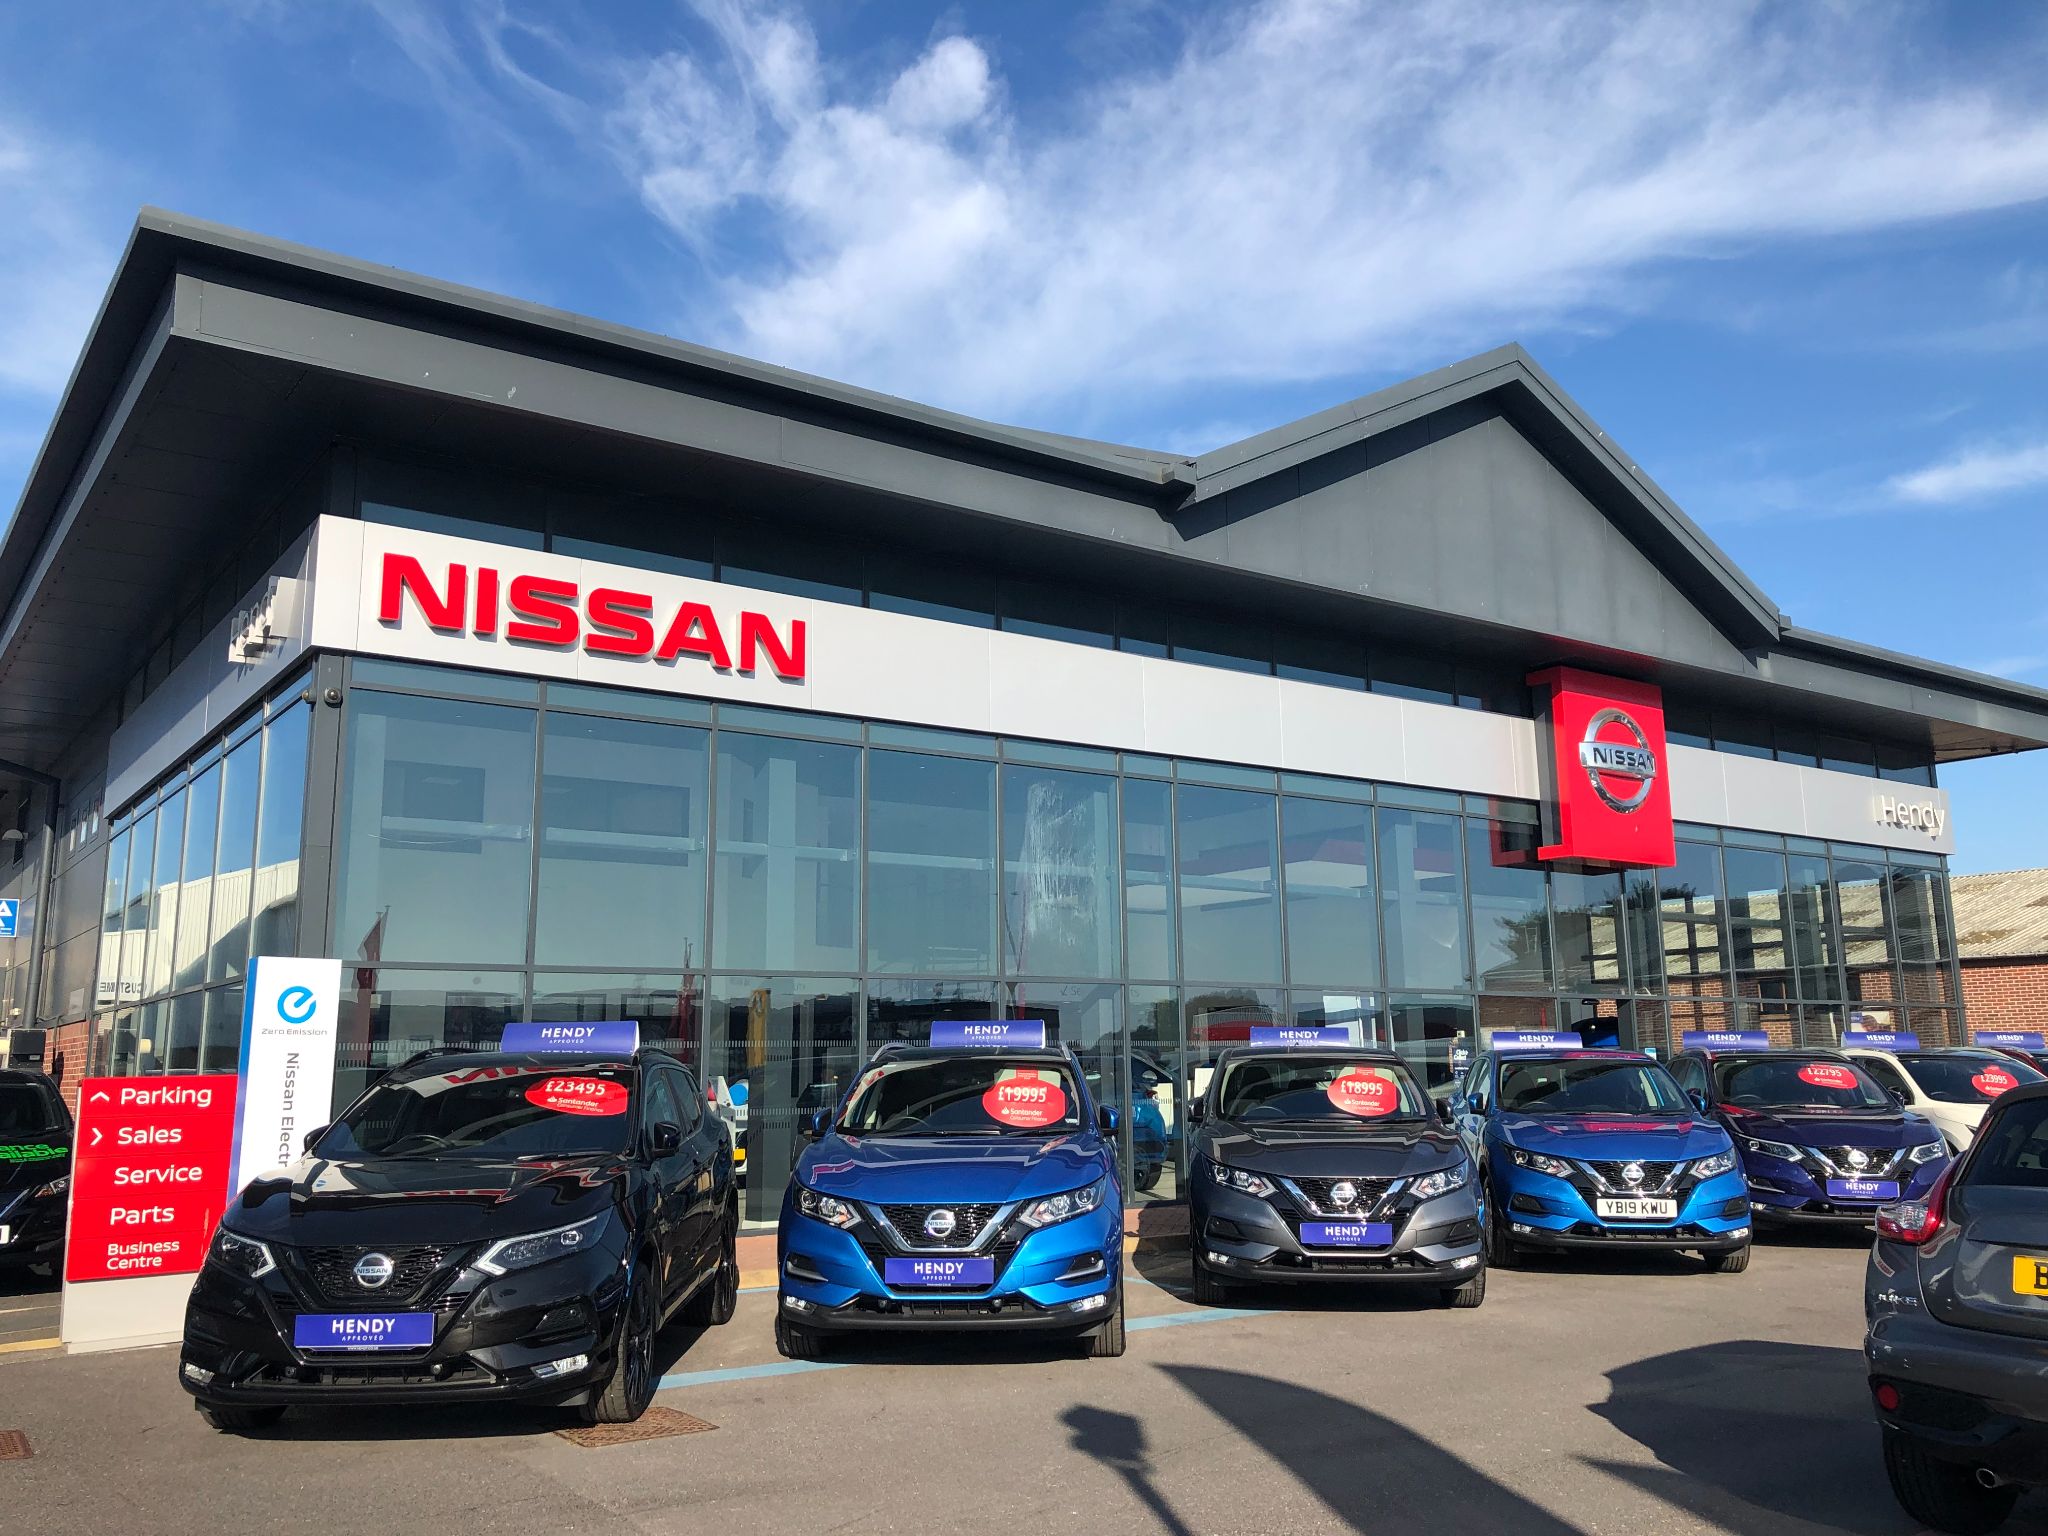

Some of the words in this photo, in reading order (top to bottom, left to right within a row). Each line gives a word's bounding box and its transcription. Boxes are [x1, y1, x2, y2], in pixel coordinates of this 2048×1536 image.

[377, 552, 806, 682] NISSAN
[1592, 747, 1655, 771] NISSAN
[1879, 794, 1945, 837] Hendy
[261, 1027, 285, 1036] Zero
[286, 1028, 328, 1036] Emission
[541, 1026, 596, 1038] HENDY
[964, 1025, 1009, 1035] HENDY
[1279, 1030, 1319, 1039] HENDY
[282, 1052, 300, 1111] Nissan
[545, 1080, 606, 1096] £23495
[1340, 1080, 1384, 1096] £18995
[120, 1087, 212, 1108] Parking
[558, 1097, 600, 1107] Santander
[998, 1085, 1048, 1103] £19995
[1010, 1107, 1043, 1116] Santander
[117, 1125, 182, 1145] Sales
[113, 1164, 203, 1185] Service
[1845, 1182, 1879, 1191] HENDY
[110, 1205, 175, 1225] Parts
[1606, 1201, 1637, 1214] YB19
[1641, 1202, 1668, 1215] KWU
[1325, 1226, 1368, 1237] HENDY
[107, 1239, 180, 1256] Business
[106, 1255, 162, 1271] Centre
[914, 1262, 964, 1275] HENDY
[331, 1318, 396, 1334] HENDY
